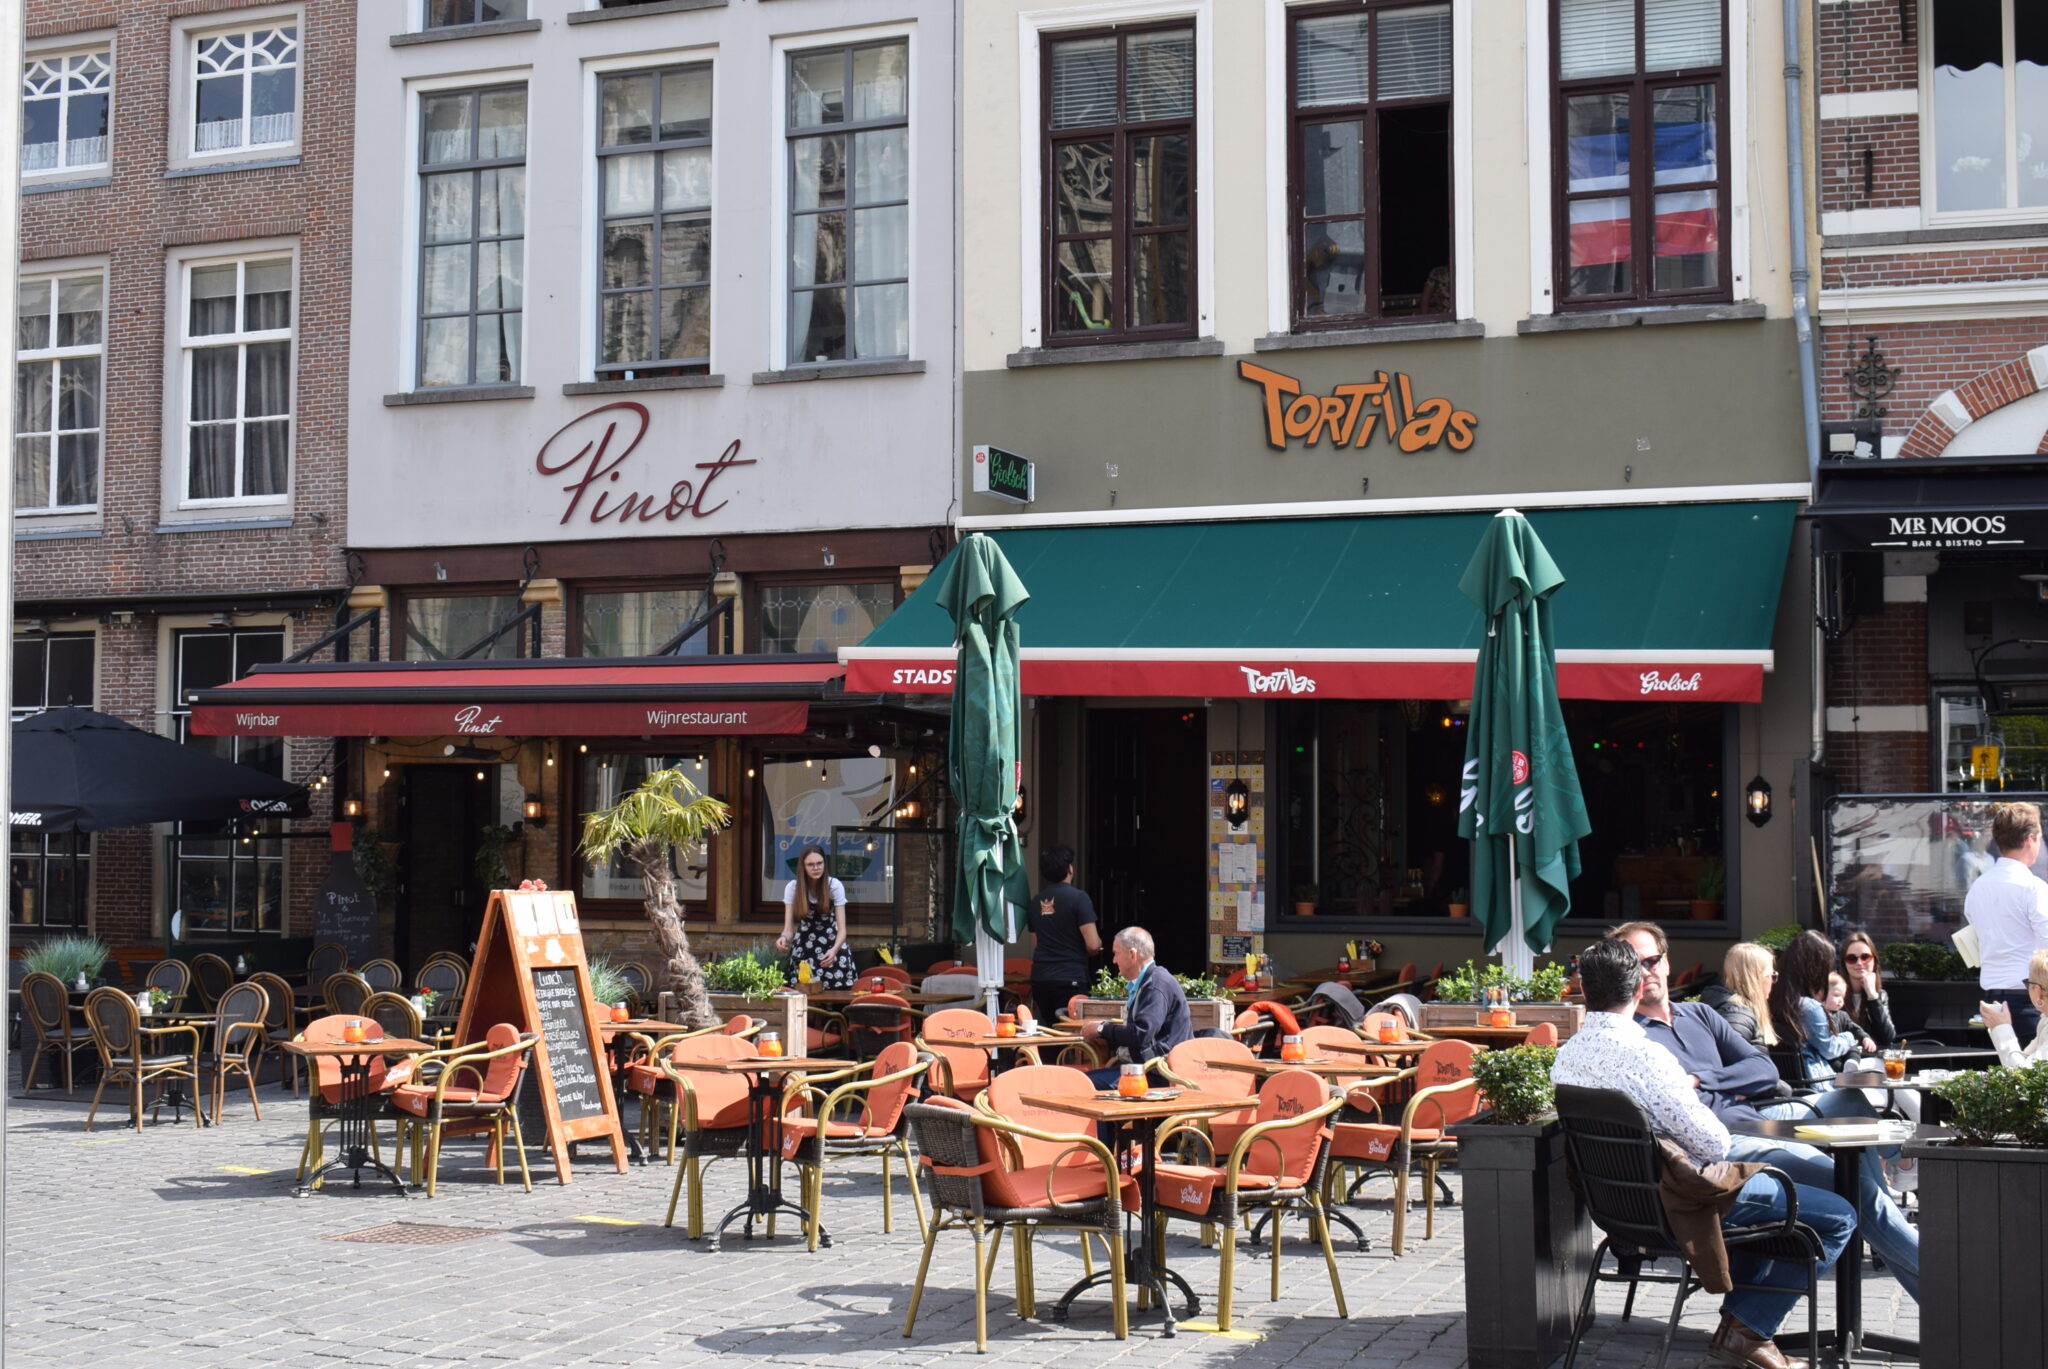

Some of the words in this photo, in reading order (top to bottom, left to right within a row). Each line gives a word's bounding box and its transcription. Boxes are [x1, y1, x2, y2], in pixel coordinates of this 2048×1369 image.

[536, 402, 757, 525] Pinot
[1930, 515, 2006, 534] MOOS
[1945, 539, 1983, 547] BISTRO
[892, 669, 957, 684] STADS
[1640, 671, 1702, 694] Grolsch
[236, 713, 280, 729] Wijnbar
[455, 706, 503, 732] Pinot
[646, 710, 748, 728] Wijnrestaurant
